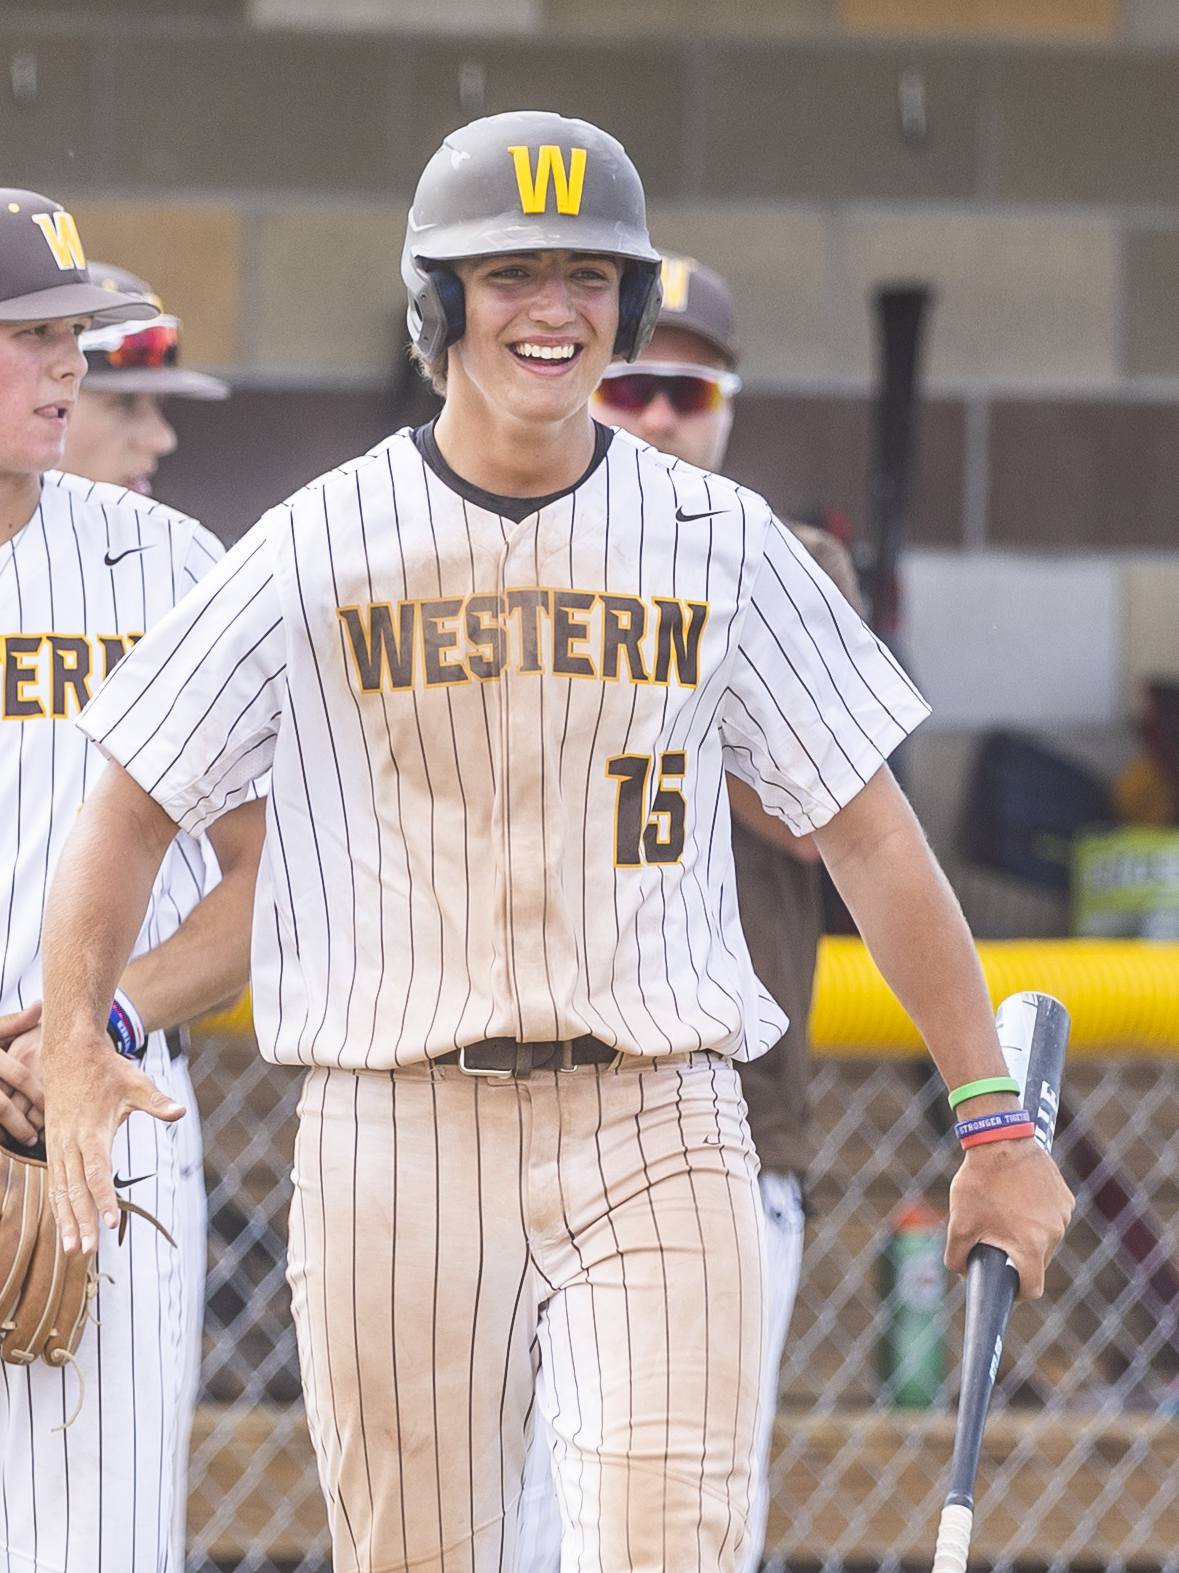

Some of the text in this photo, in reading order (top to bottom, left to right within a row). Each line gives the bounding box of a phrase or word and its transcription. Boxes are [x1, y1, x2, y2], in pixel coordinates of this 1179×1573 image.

[509, 145, 587, 215] W
[31, 210, 87, 271] W
[335, 586, 709, 695] WESTERN
[605, 749, 687, 868] 15
[959, 1116, 1002, 1135] STRONGER
